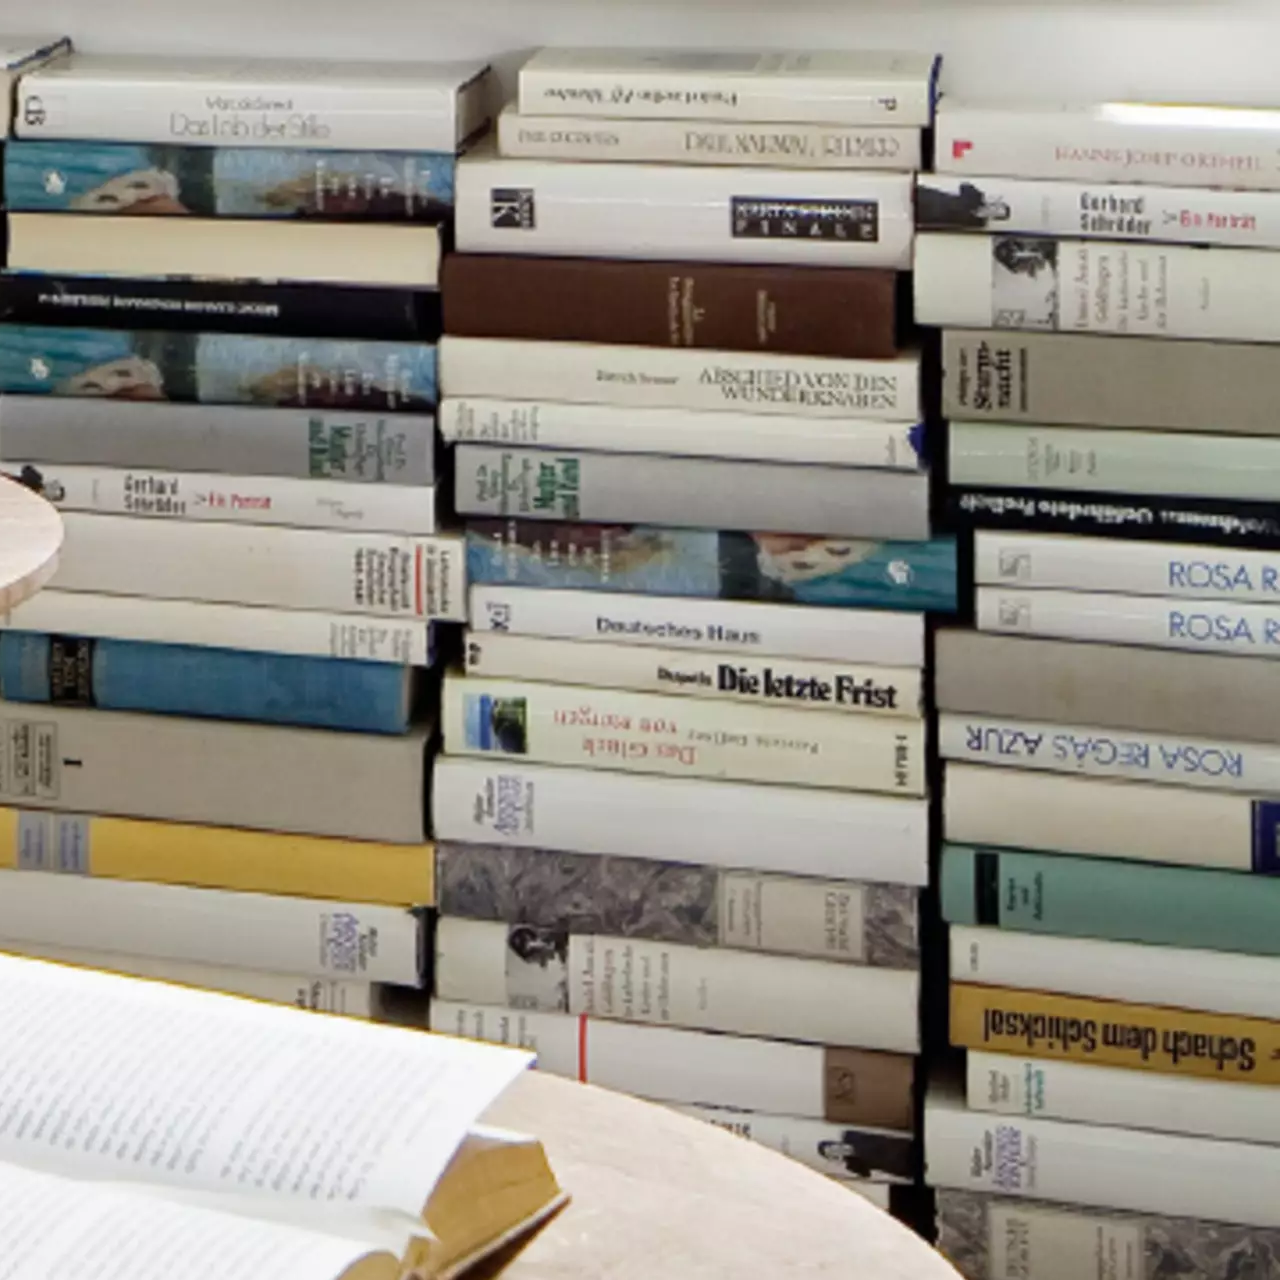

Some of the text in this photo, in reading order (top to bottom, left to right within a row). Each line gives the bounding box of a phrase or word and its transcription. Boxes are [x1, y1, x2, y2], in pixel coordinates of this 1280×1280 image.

[698, 366, 800, 391] ABSCHIED
[1168, 561, 1254, 592] ROSA
[707, 625, 762, 645] Haus
[1168, 611, 1255, 644] ROSA
[717, 664, 761, 695] Die
[763, 668, 832, 702] letzte
[835, 675, 898, 709] Frist
[965, 726, 1043, 756] AZUR
[1158, 743, 1244, 778] ROSA
[982, 1008, 1257, 1073] Schicksal dem Schach
